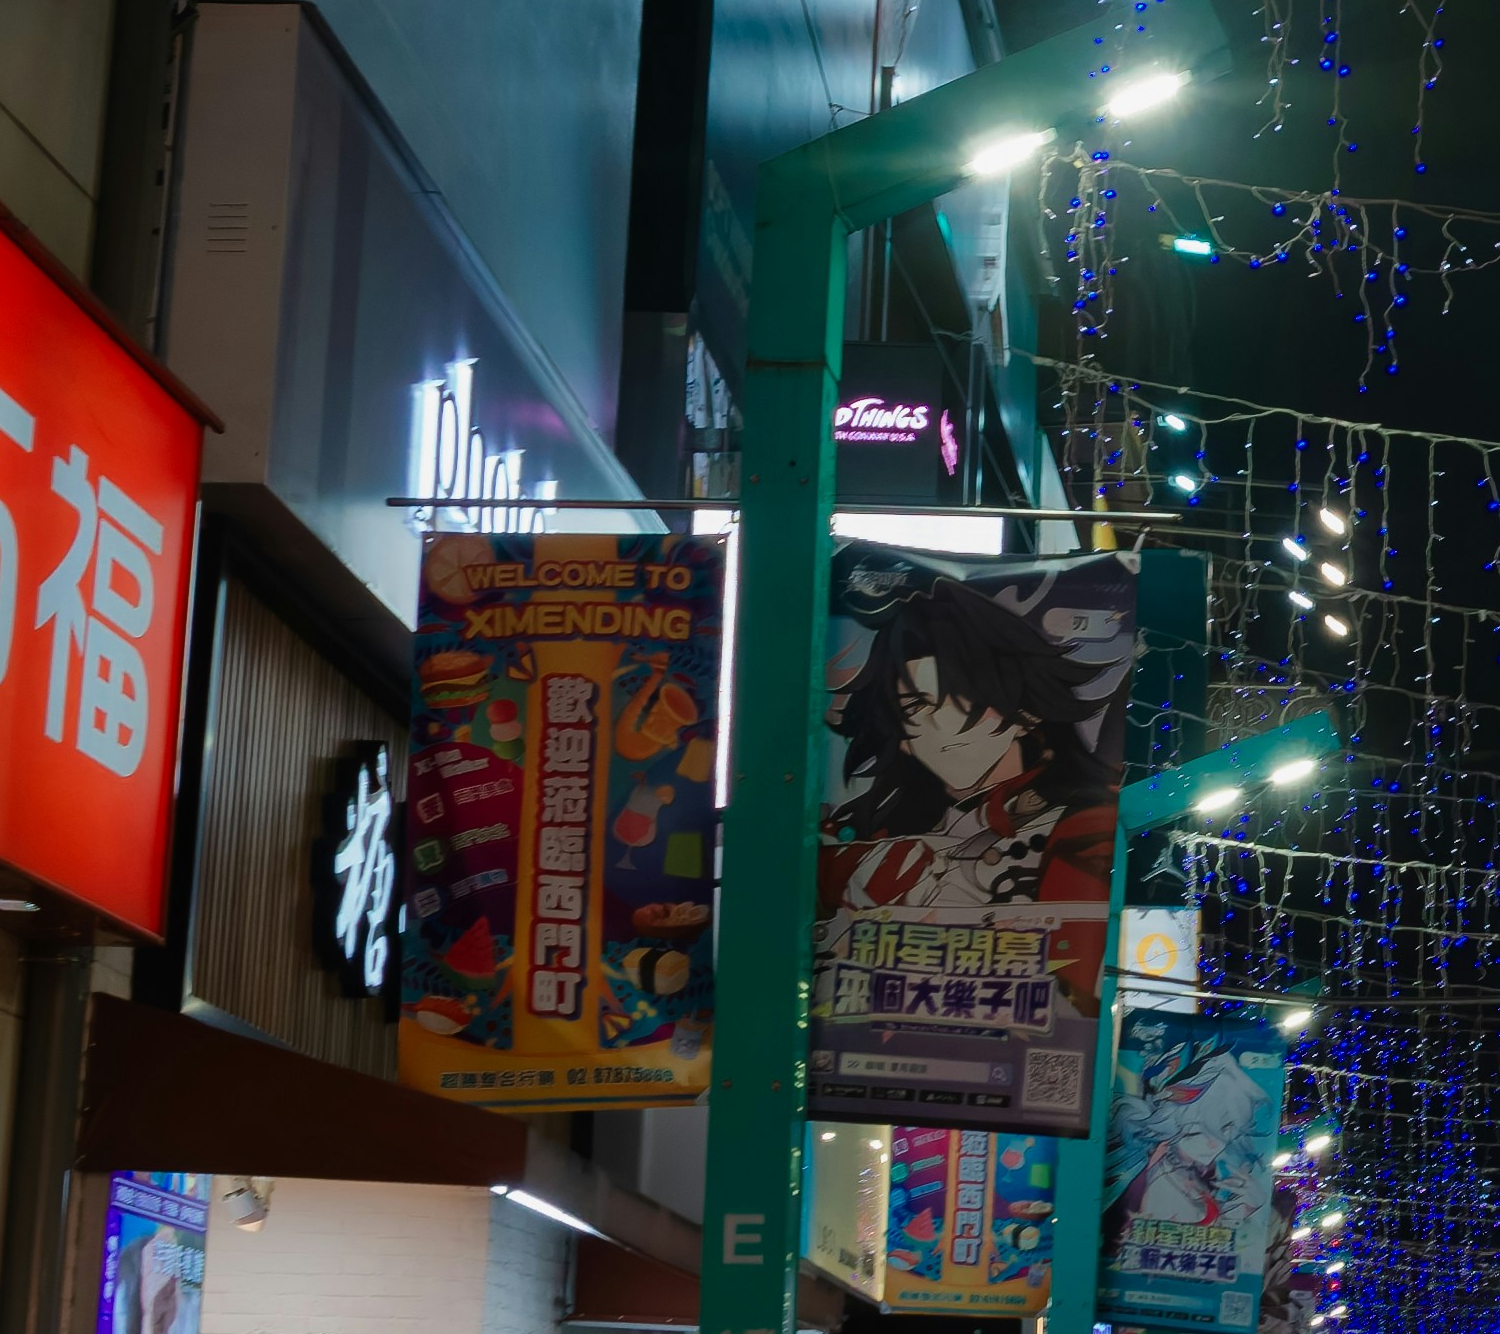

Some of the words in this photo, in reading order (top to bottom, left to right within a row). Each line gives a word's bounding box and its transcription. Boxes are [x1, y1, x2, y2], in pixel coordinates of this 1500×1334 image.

[465, 561, 635, 590] WELCOME
[647, 562, 691, 591] TO
[460, 602, 692, 641] XIMENDING
[531, 676, 593, 1015] 歡迎蒞臨西門町
[851, 919, 1047, 979] 新星開幕
[835, 975, 1051, 1033] 來個大樂子吧
[722, 1214, 765, 1264] E
